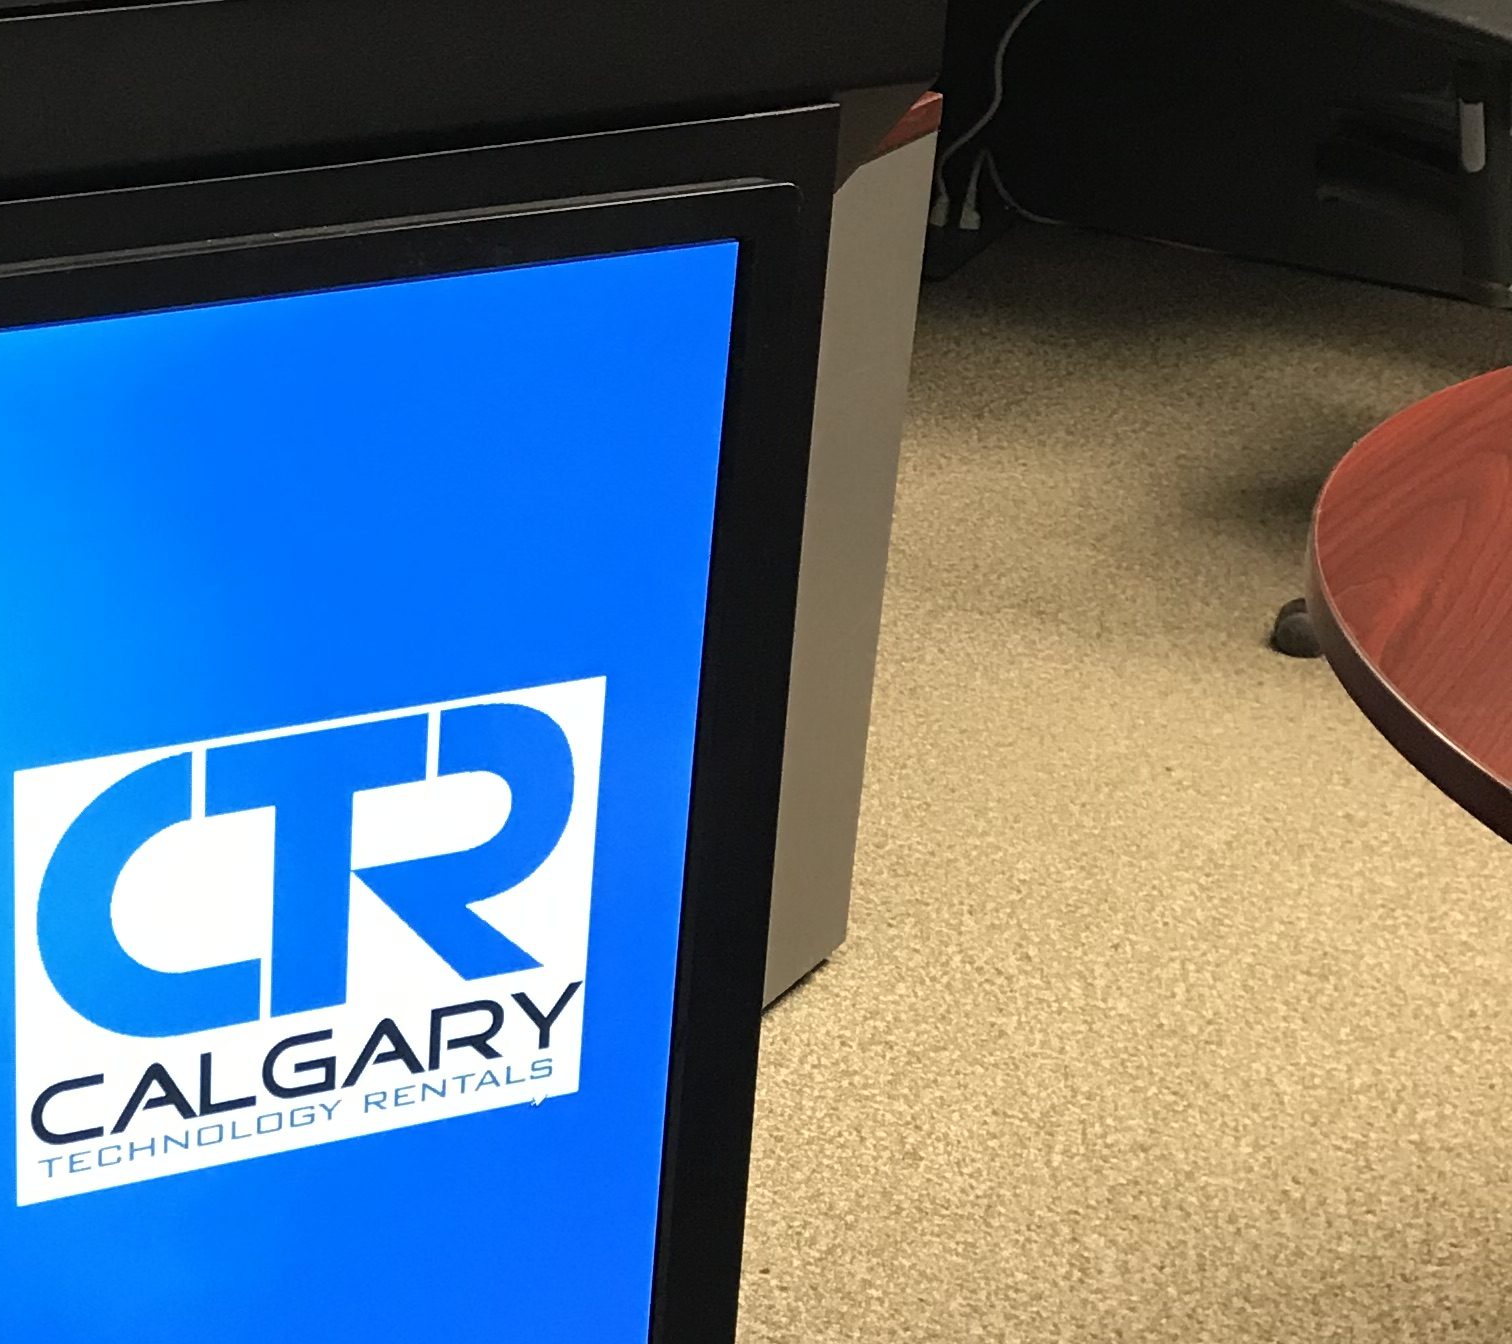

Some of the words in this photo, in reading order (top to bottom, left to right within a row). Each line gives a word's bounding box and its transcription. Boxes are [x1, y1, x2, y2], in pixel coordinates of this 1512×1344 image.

[36, 702, 575, 1038] CTR
[30, 981, 583, 1145] CALGARY
[38, 1099, 343, 1178] TECHNOLOGY
[364, 1058, 554, 1113] RENTALS
